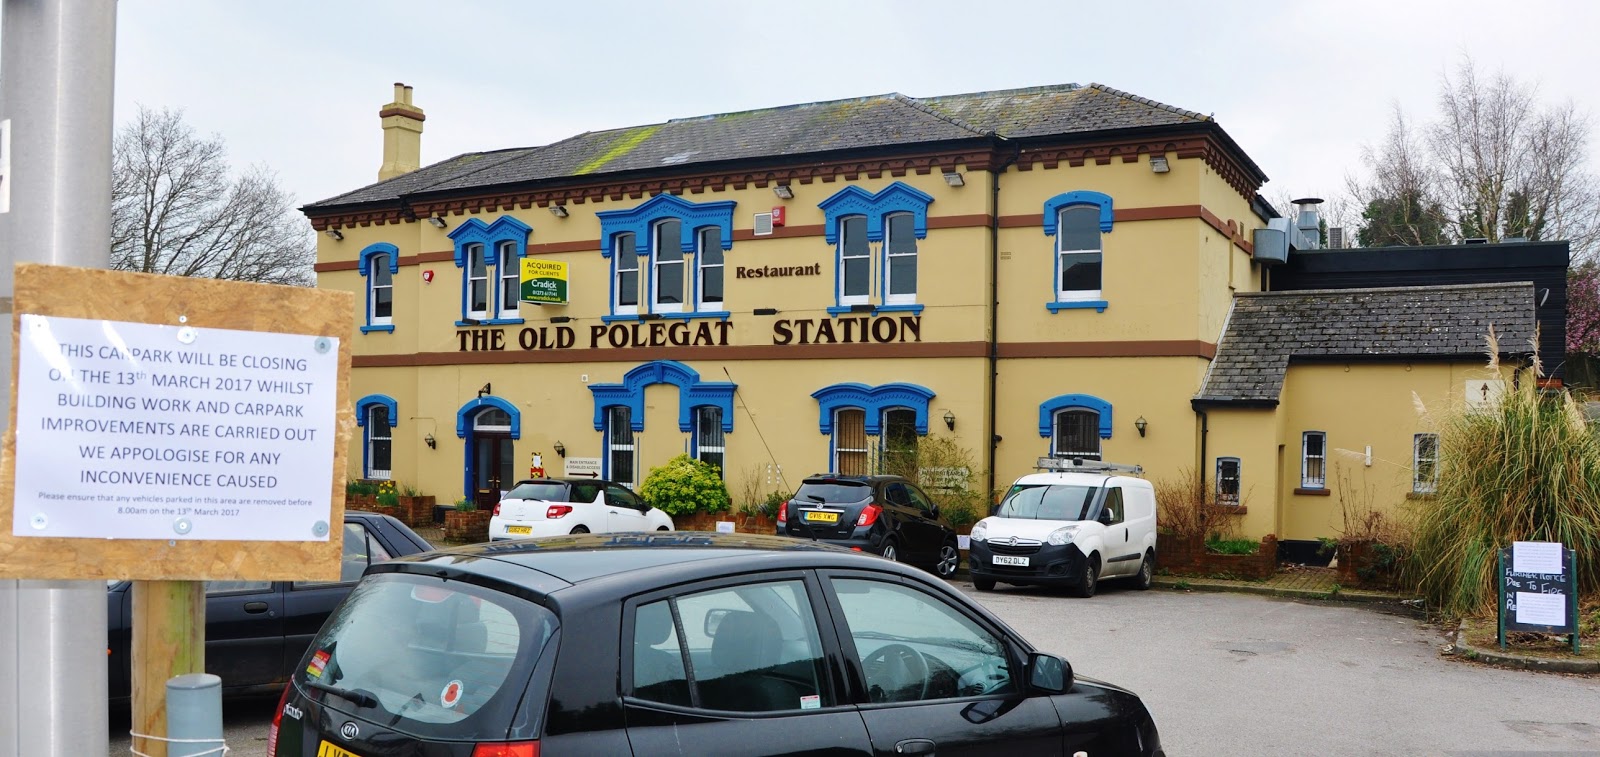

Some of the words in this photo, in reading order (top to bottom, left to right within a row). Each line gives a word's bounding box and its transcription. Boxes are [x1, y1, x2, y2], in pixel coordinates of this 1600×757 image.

[527, 262, 561, 270] ACQUIRED
[736, 262, 821, 279] Restaurant
[531, 279, 557, 289] Cradick
[456, 329, 506, 351] THE
[518, 326, 576, 350] OLD
[590, 322, 734, 349] POLEGAT
[773, 316, 921, 345] STATION
[60, 343, 93, 358] THIS
[177, 351, 214, 366] WILL
[219, 354, 238, 367] BE
[242, 355, 307, 372] CLOSING
[48, 368, 75, 382] O
[80, 370, 111, 384] THE
[152, 373, 210, 389] MARCH
[215, 377, 252, 392] 2017
[257, 380, 313, 395] WHILST
[58, 393, 136, 410] BUILDING
[142, 397, 191, 412] WORK
[196, 401, 230, 414] AND
[234, 402, 304, 418] CARPARK
[41, 417, 175, 436] IMPROVEMENTS
[180, 424, 210, 437] ARE
[215, 425, 280, 440] CARRIED
[284, 428, 317, 441] OUT
[79, 445, 105, 459] WE
[110, 446, 210, 462] APPOLOGISE
[215, 451, 245, 464] FOR
[249, 452, 281, 465] ANY
[80, 470, 212, 487] INCONVENIENCE
[216, 474, 278, 488] CAUSED
[38, 492, 65, 500] Please
[116, 495, 130, 503] any
[165, 496, 193, 504] parked
[288, 498, 312, 506] before
[1013, 557, 1026, 565] DLZ
